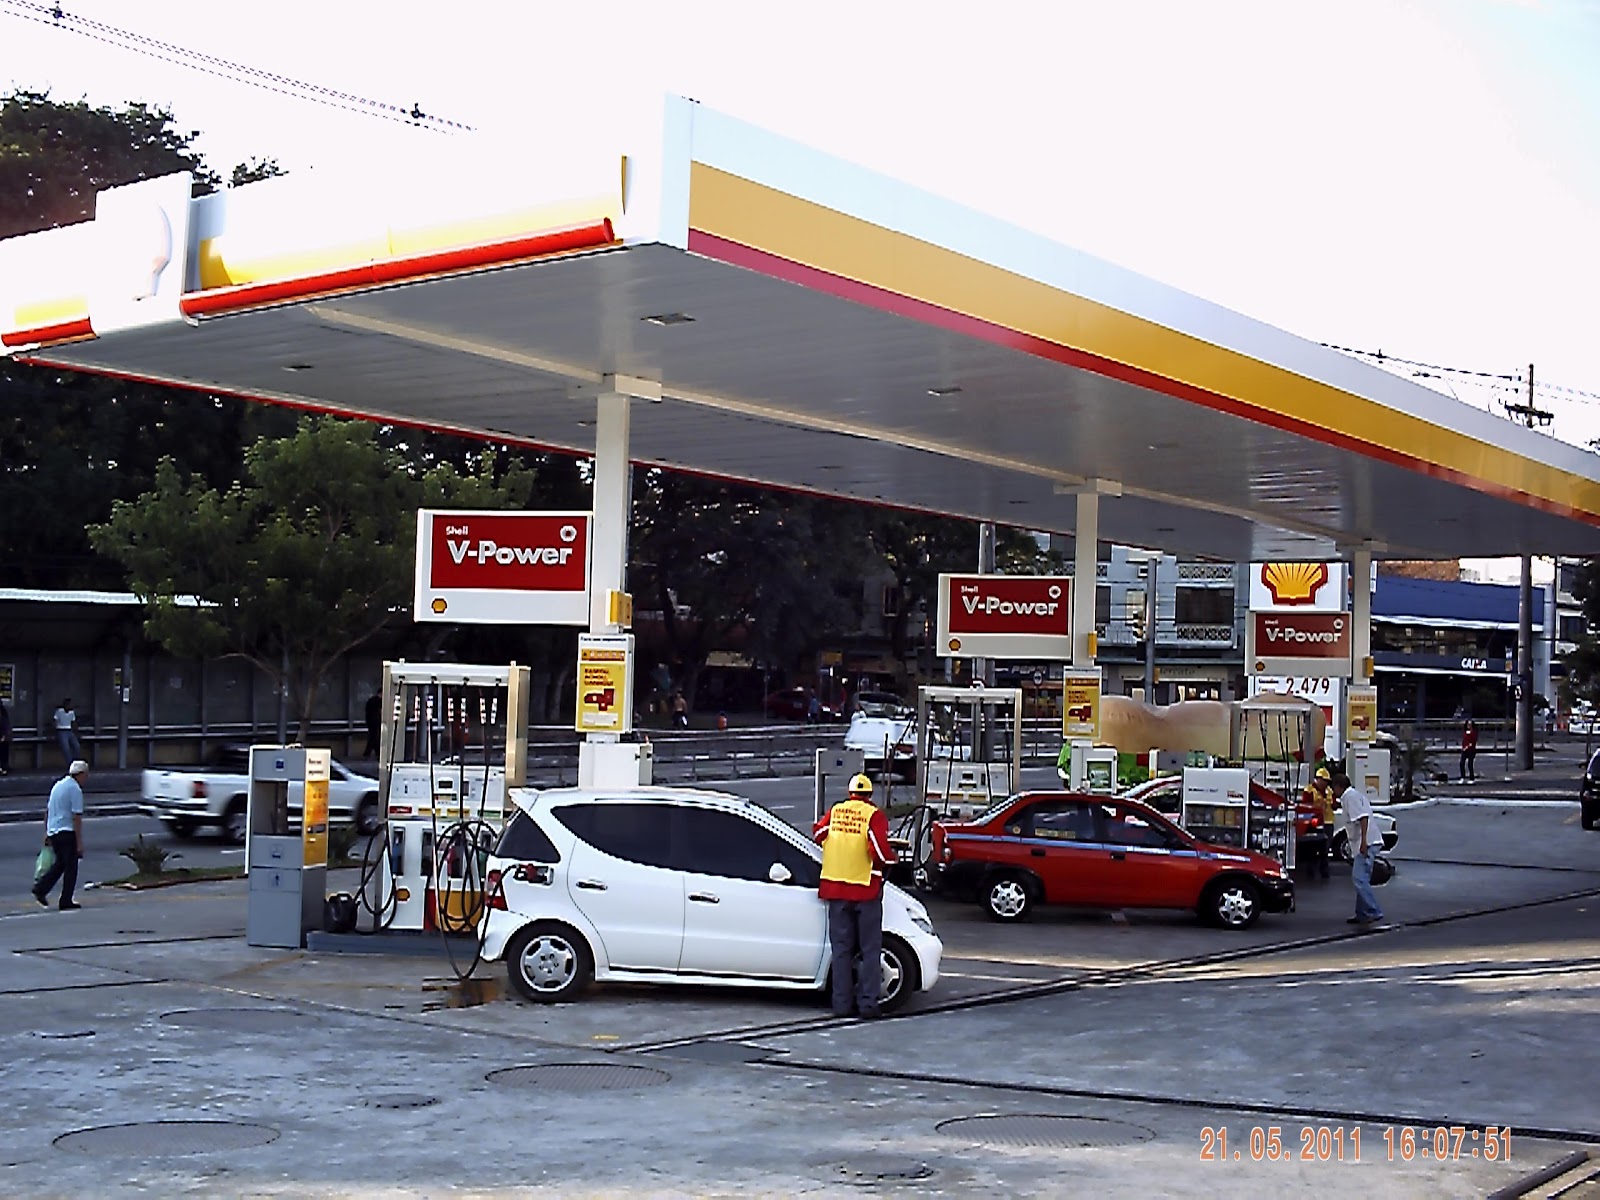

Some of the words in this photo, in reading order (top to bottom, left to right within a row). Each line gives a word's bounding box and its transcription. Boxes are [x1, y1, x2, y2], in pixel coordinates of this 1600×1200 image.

[446, 525, 469, 535] Shell
[447, 540, 573, 565] V-Power
[962, 595, 1059, 616] V-Power
[1265, 627, 1341, 643] V-Power
[1286, 677, 1330, 695] 2.479
